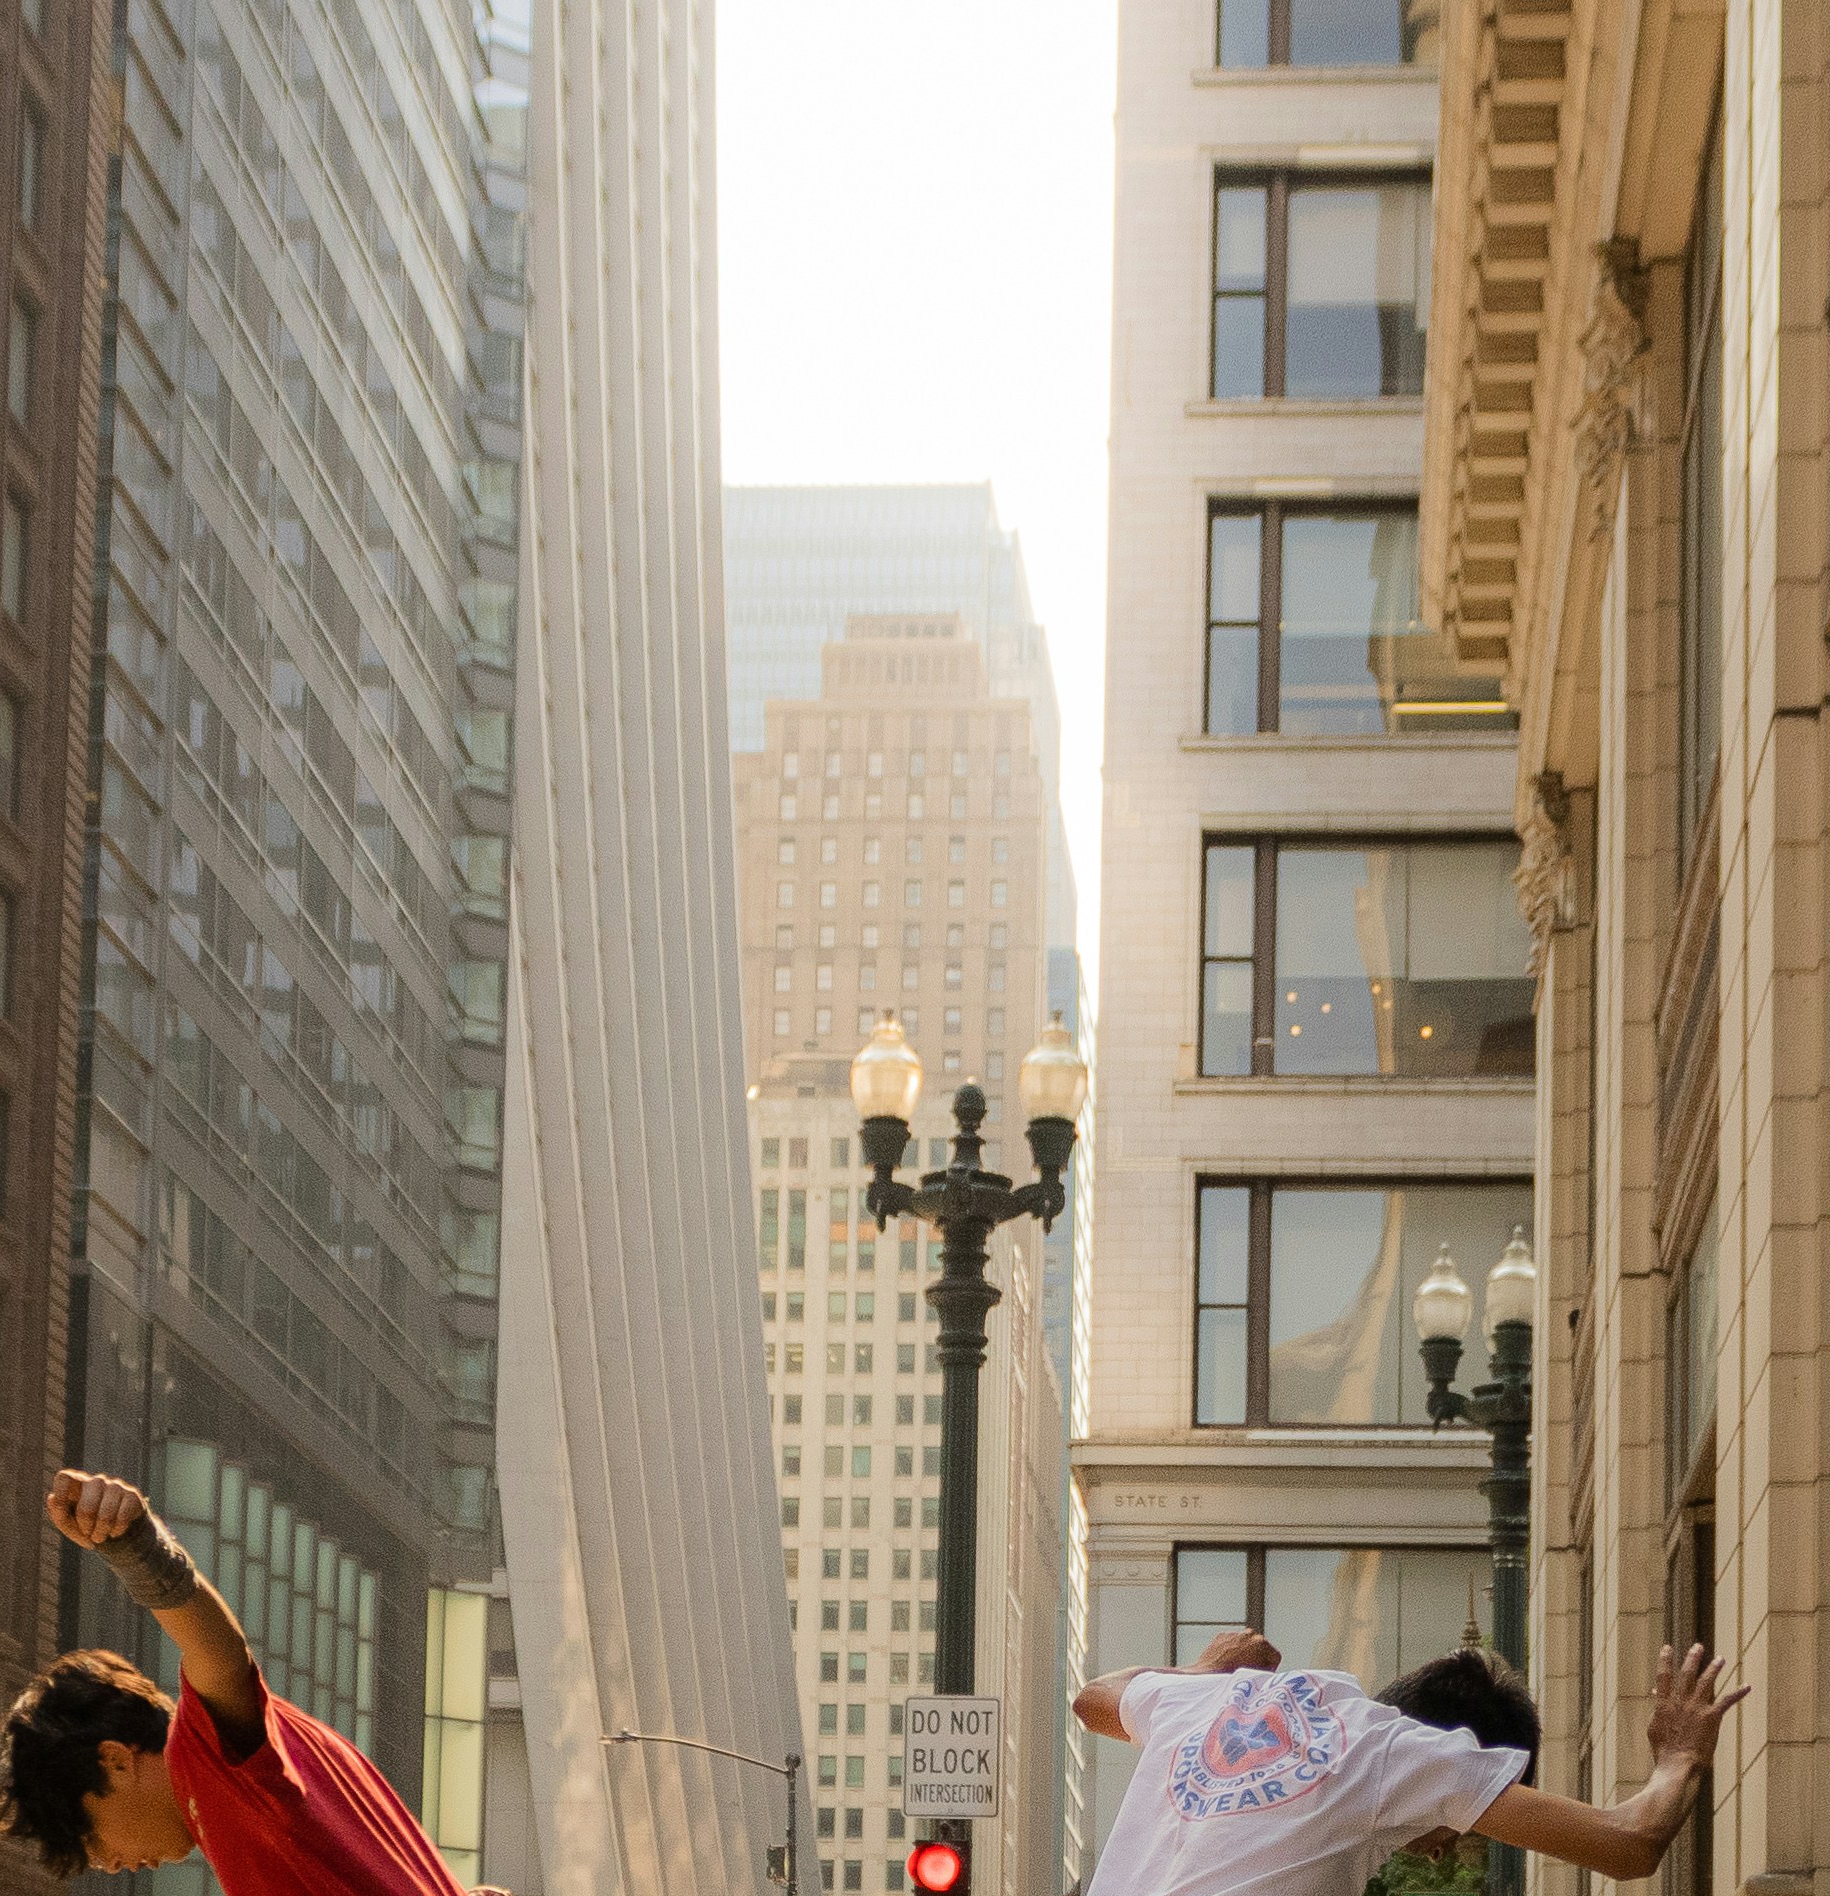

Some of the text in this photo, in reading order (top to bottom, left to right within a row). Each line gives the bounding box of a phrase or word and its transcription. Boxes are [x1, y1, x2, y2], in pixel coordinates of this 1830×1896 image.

[1114, 1495, 1167, 1508] STATE
[912, 1710, 993, 1735] DO NOT
[912, 1748, 990, 1774] BLOCK
[910, 1783, 993, 1804] INTERSECTION
